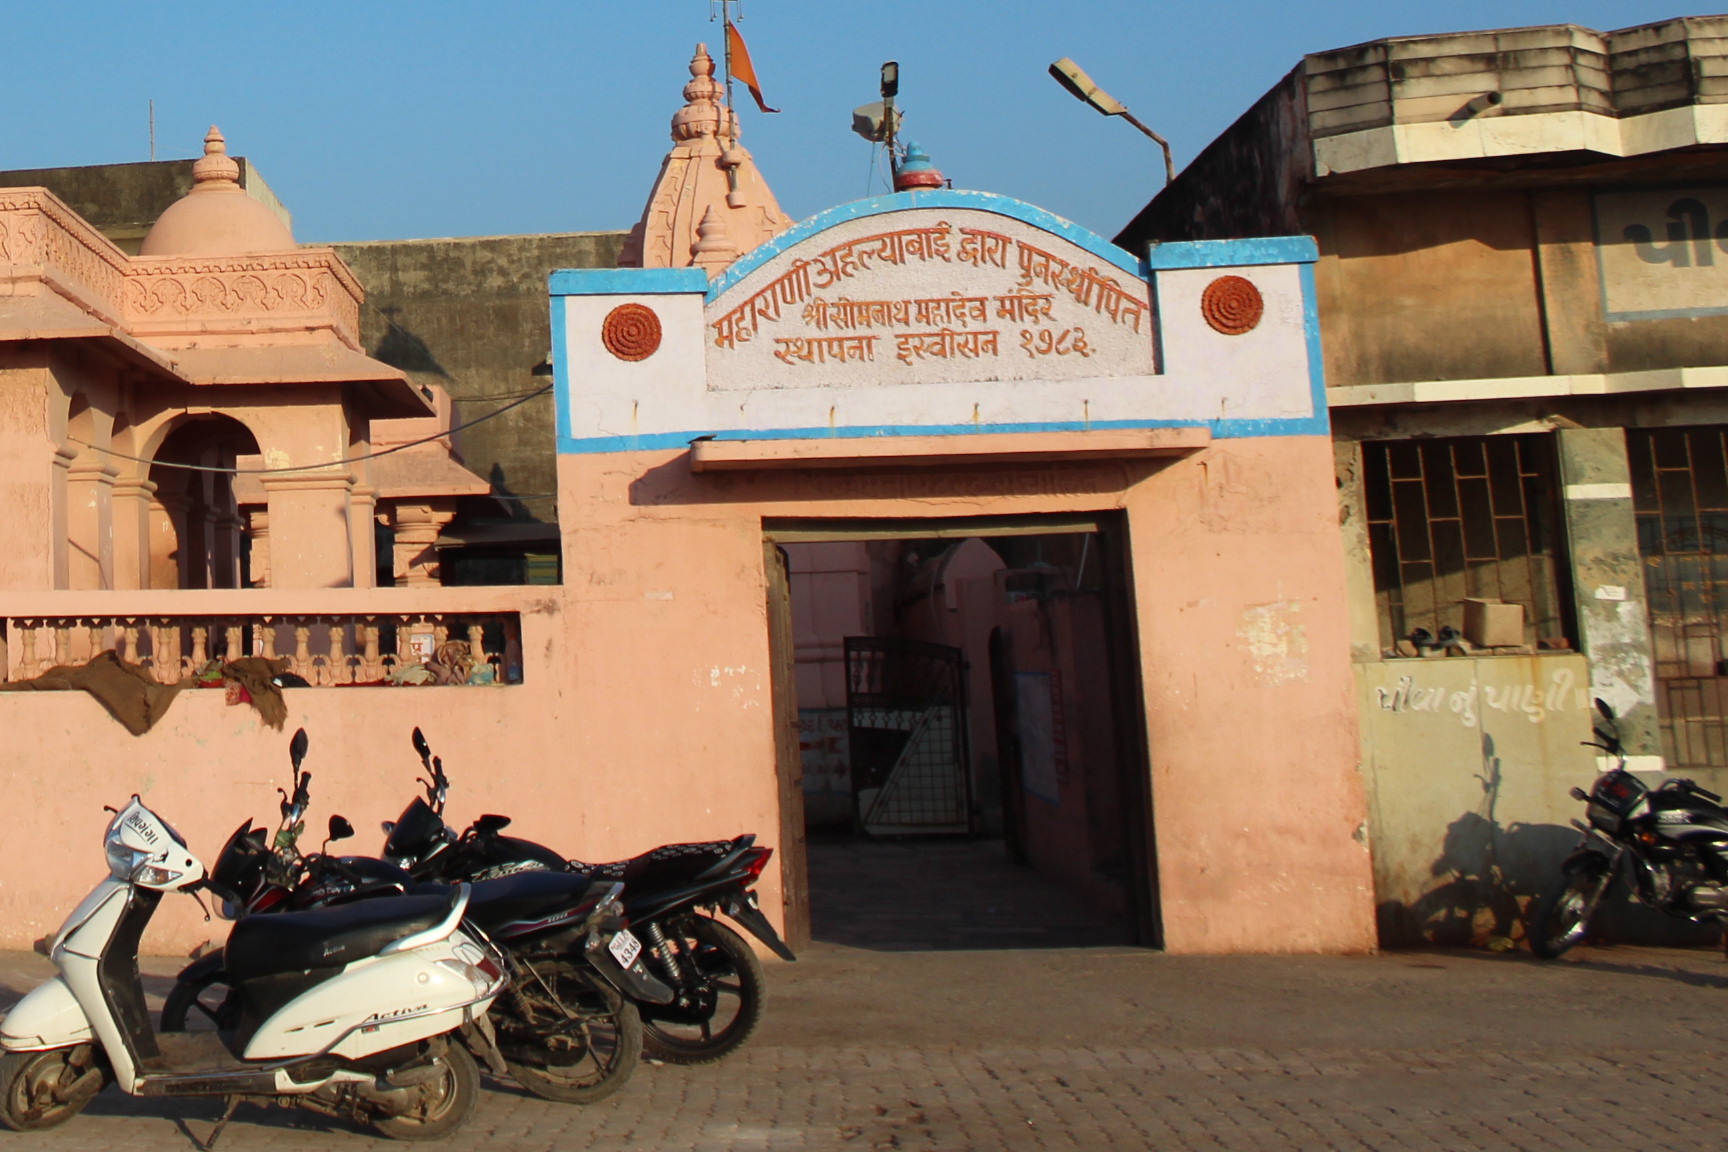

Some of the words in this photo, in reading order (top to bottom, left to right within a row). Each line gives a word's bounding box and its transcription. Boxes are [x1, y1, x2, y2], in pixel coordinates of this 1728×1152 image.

[1623, 197, 1728, 268] પી
[712, 259, 812, 350] महाराणी
[812, 220, 953, 289] अहल्याबाई
[957, 227, 1013, 269] द्वारा
[914, 291, 988, 328] महादेव
[994, 288, 1057, 325] मंदिर
[774, 334, 880, 366] स्थापना
[894, 327, 1000, 366] इस्वीसन
[362, 1002, 429, 1024] Activa
